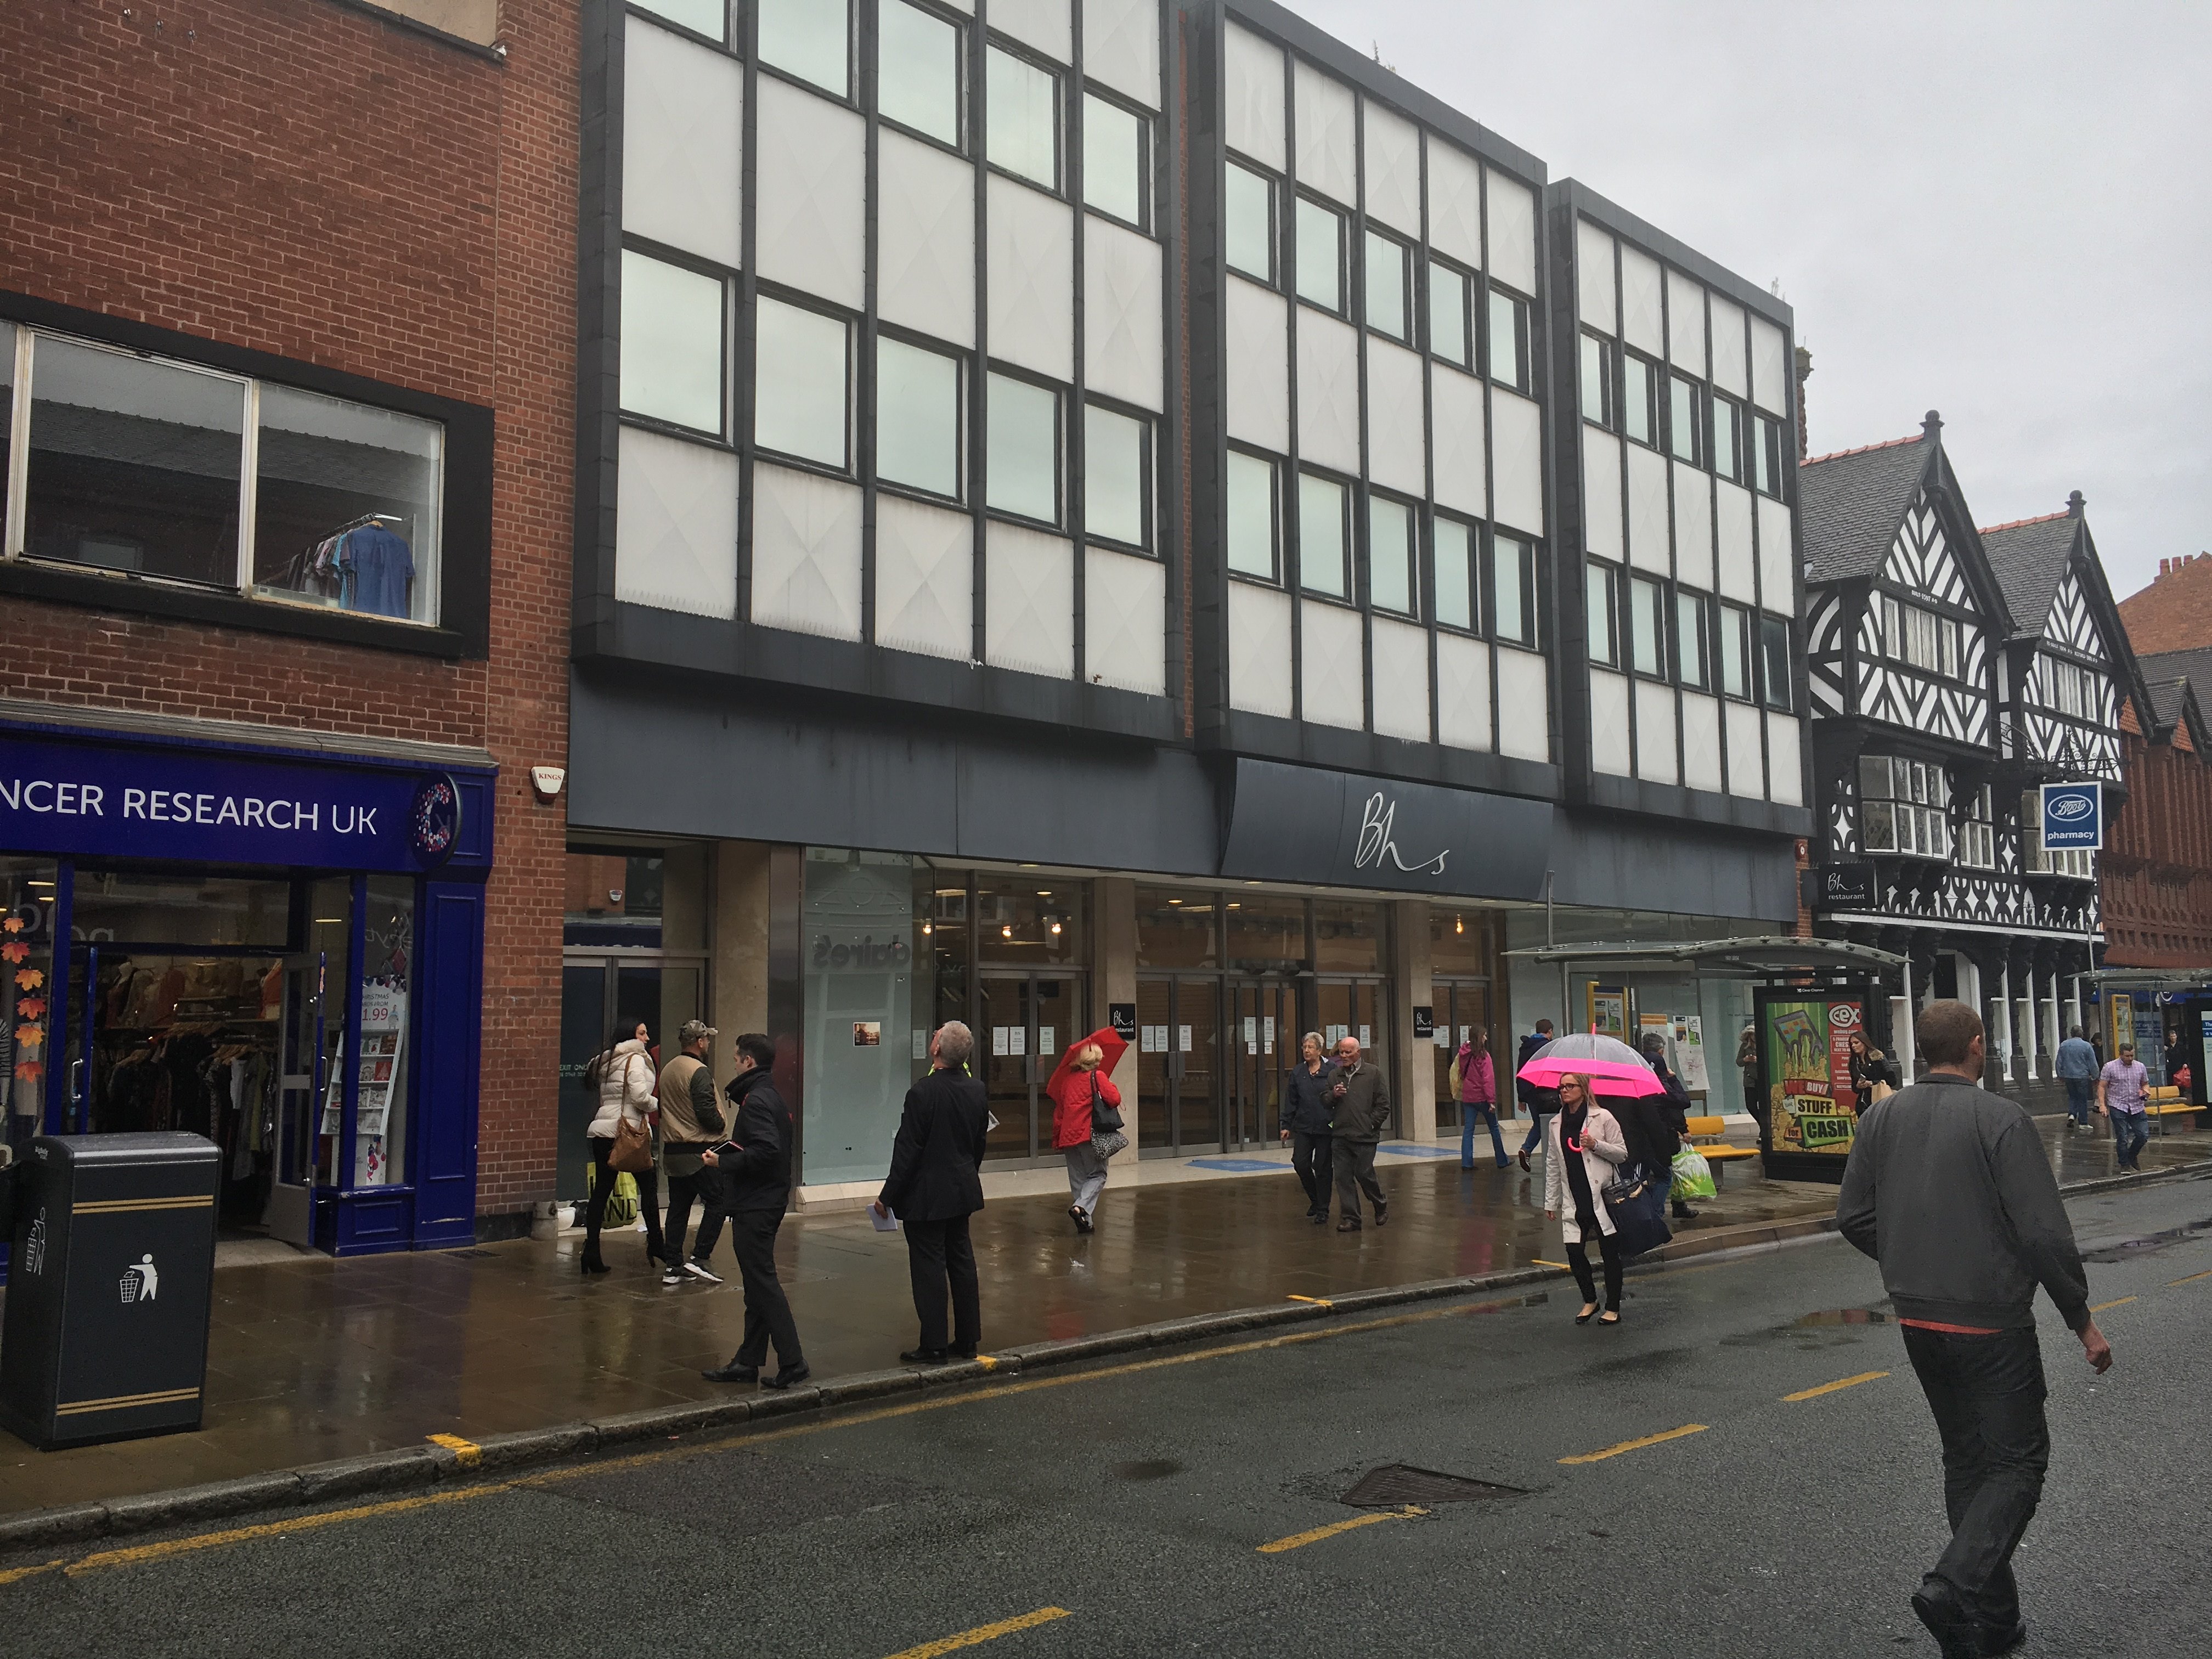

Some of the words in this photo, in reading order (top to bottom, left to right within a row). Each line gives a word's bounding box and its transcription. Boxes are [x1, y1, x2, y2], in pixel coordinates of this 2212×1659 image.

[538, 772, 562, 781] KINGS
[123, 788, 319, 831] RESEARCH
[332, 805, 377, 835] UK
[2055, 799, 2086, 816] Boots
[1353, 792, 1450, 876] Bhs
[2047, 831, 2095, 840] pharmacy
[1827, 872, 1865, 891] Bhs
[1113, 1010, 1134, 1026] Bhs
[1807, 1081, 1824, 1093] BUY
[1798, 1099, 1832, 1114] STUFF
[1788, 1128, 1798, 1137] for
[1807, 1120, 1848, 1138] CASH
